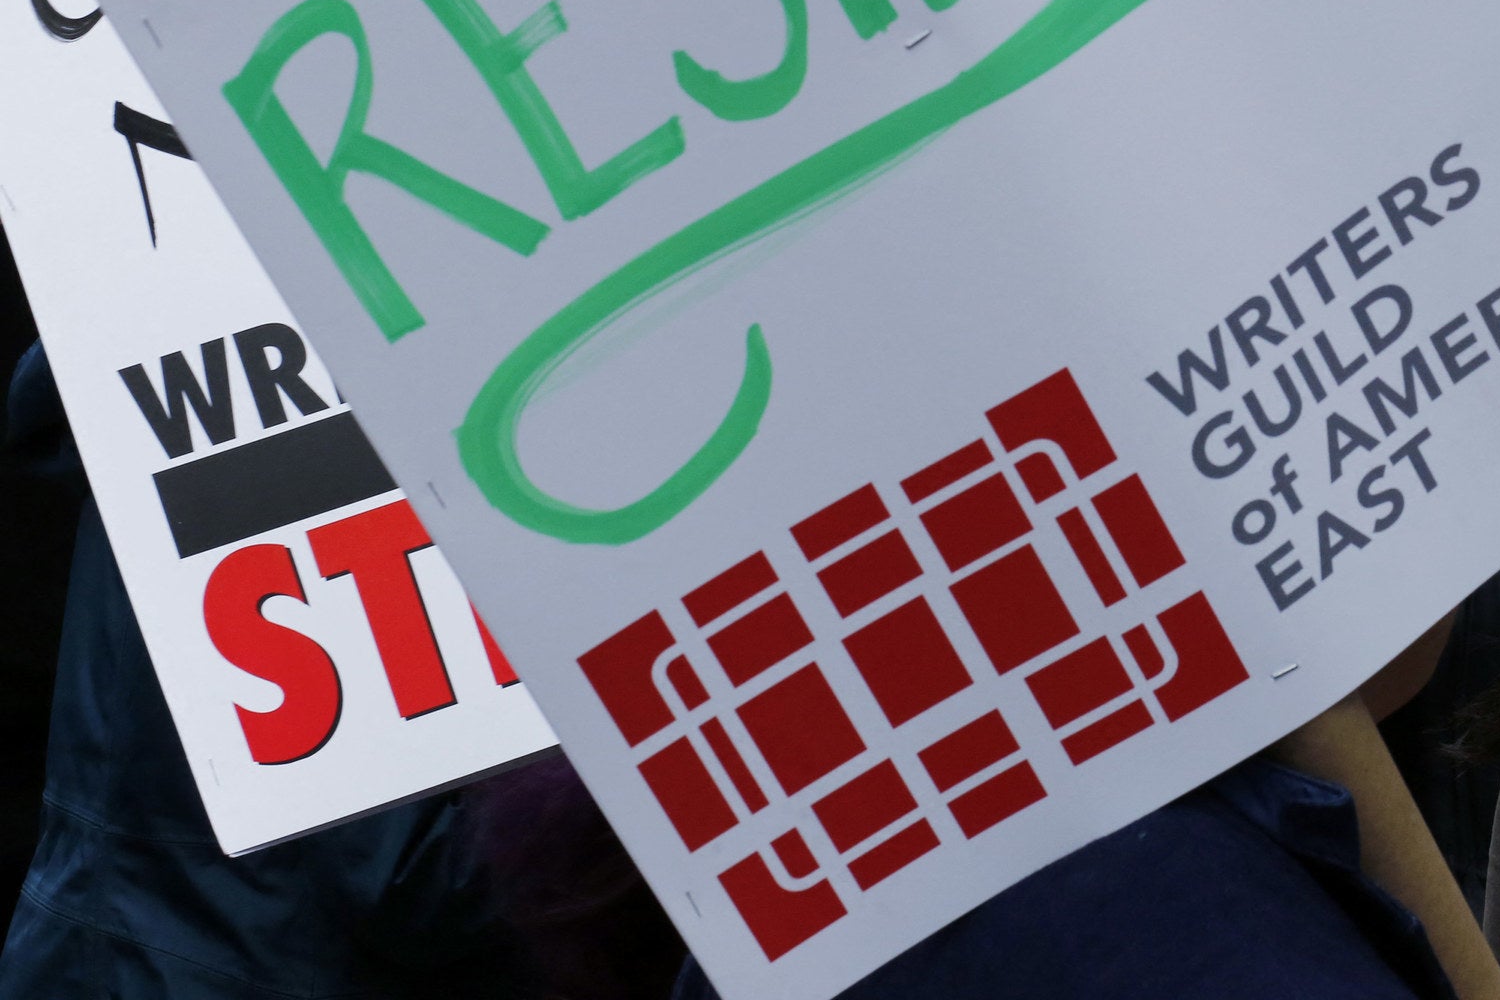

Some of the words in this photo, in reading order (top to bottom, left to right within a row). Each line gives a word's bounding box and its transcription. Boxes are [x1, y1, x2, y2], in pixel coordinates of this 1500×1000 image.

[1145, 143, 1481, 417] WRITERS
[118, 322, 347, 461] WR
[1191, 284, 1414, 479] GUILD
[1231, 454, 1303, 546] of
[1255, 427, 1439, 612] EAST
[203, 498, 520, 766] ST
